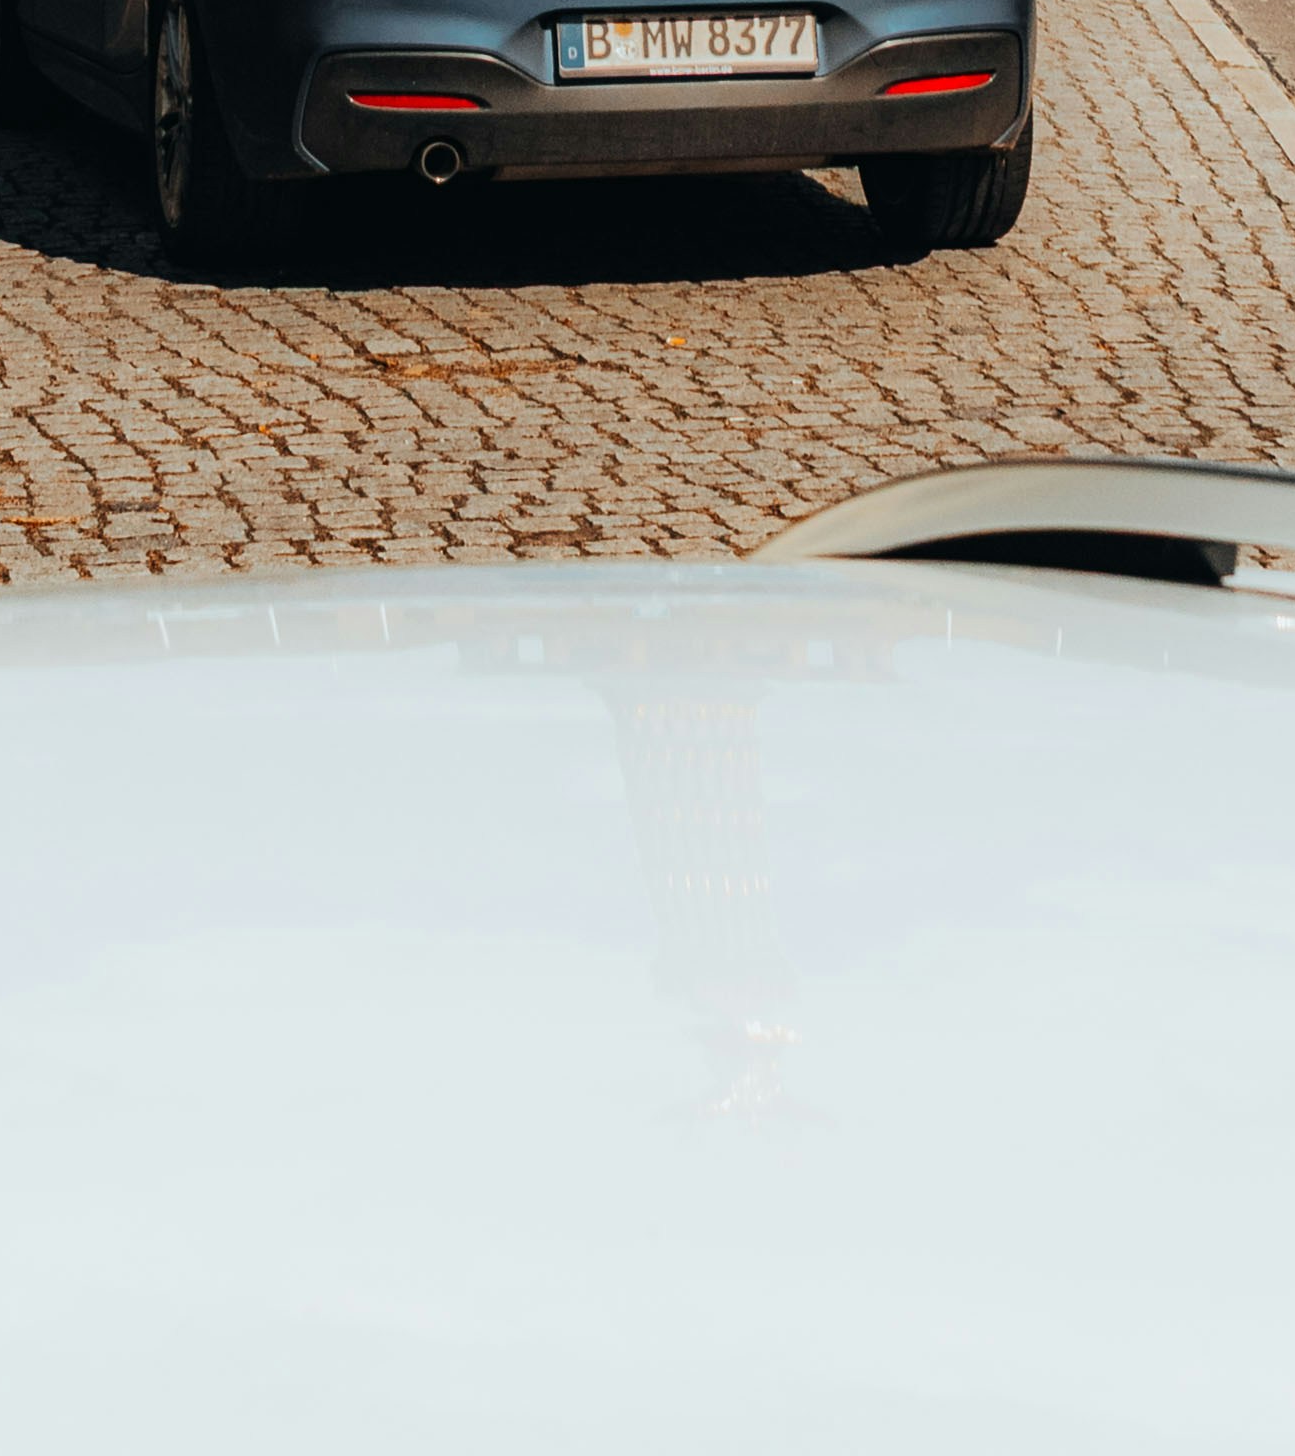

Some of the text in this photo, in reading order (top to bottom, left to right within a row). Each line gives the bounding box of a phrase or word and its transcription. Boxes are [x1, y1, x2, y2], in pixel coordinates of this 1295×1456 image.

[585, 15, 807, 60] B MW 8377
